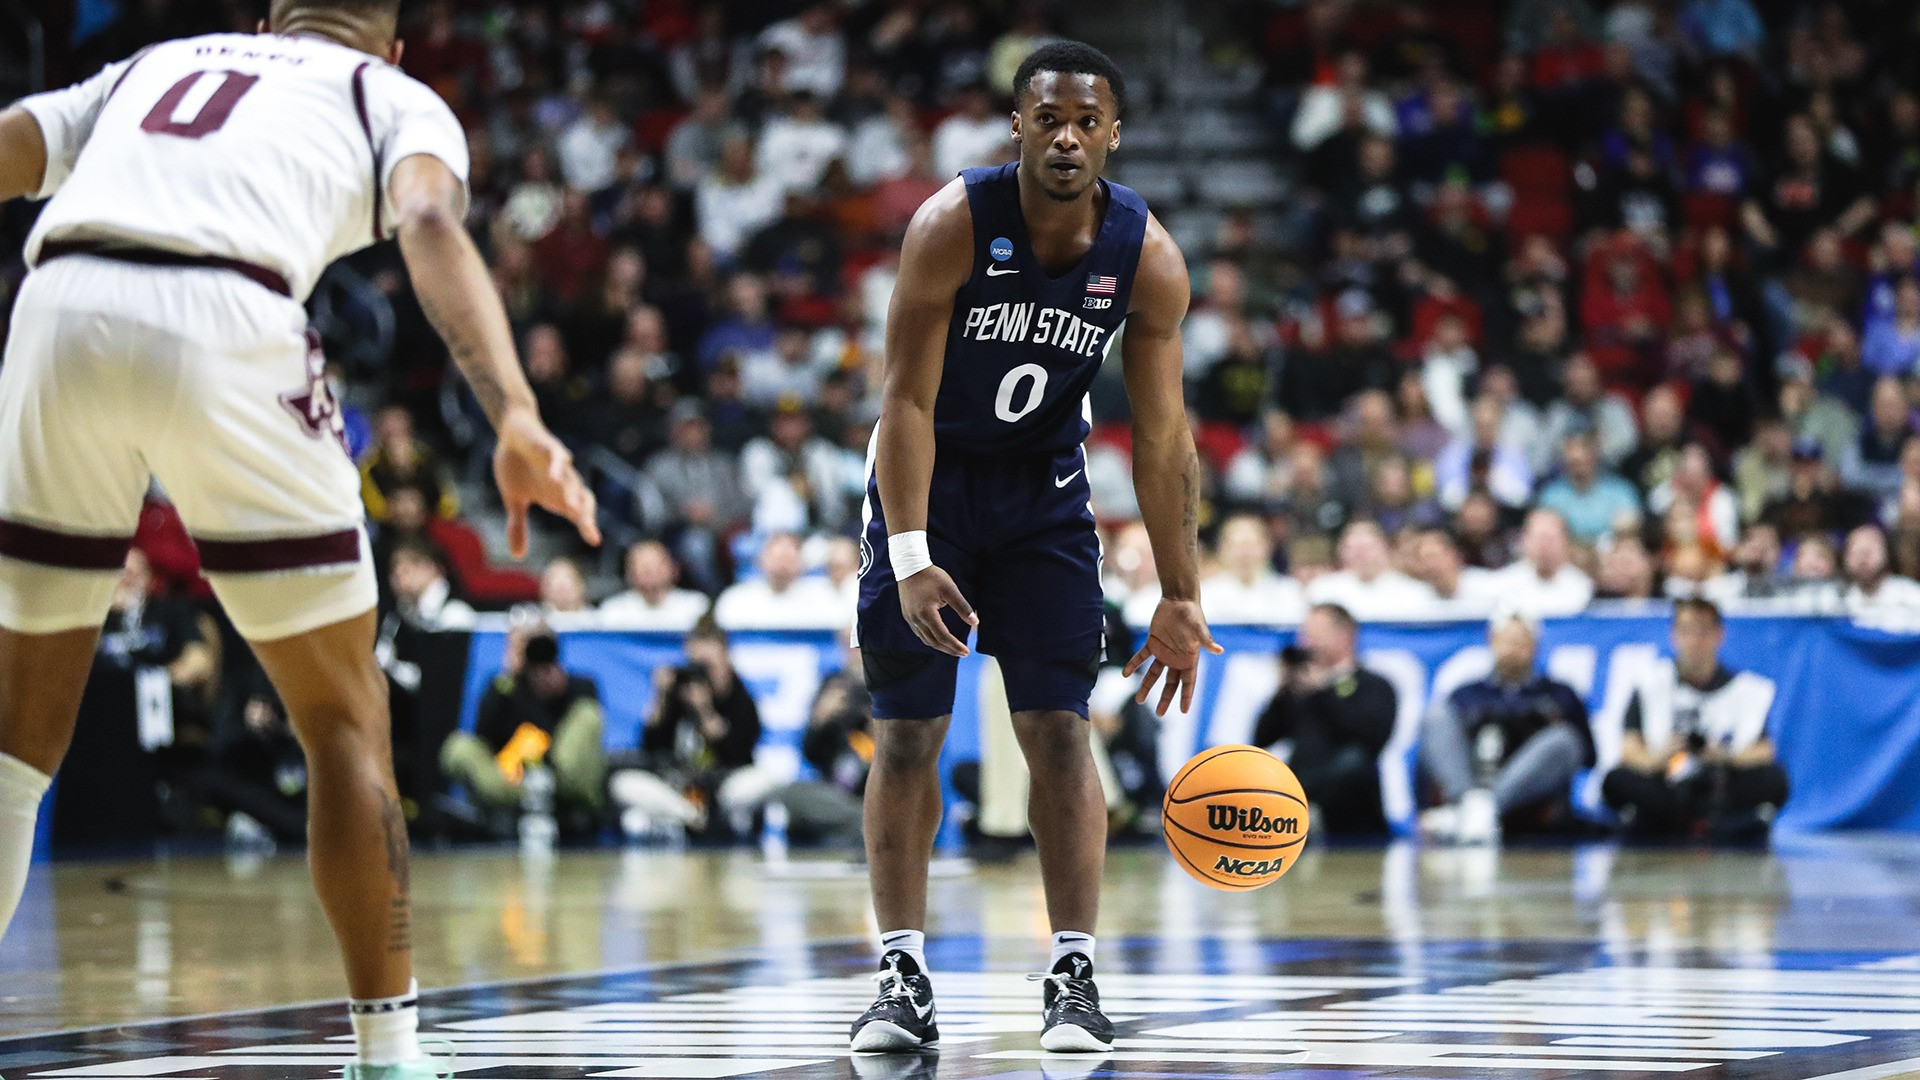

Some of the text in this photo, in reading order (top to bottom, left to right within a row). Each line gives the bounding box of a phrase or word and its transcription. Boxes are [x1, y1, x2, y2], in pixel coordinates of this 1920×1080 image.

[140, 69, 260, 139] 0
[992, 247, 1013, 256] NCAA
[963, 302, 1105, 357] PENN STATE
[995, 363, 1048, 423] 0
[1206, 804, 1298, 834] Wilson
[1213, 855, 1283, 876] NCAA
